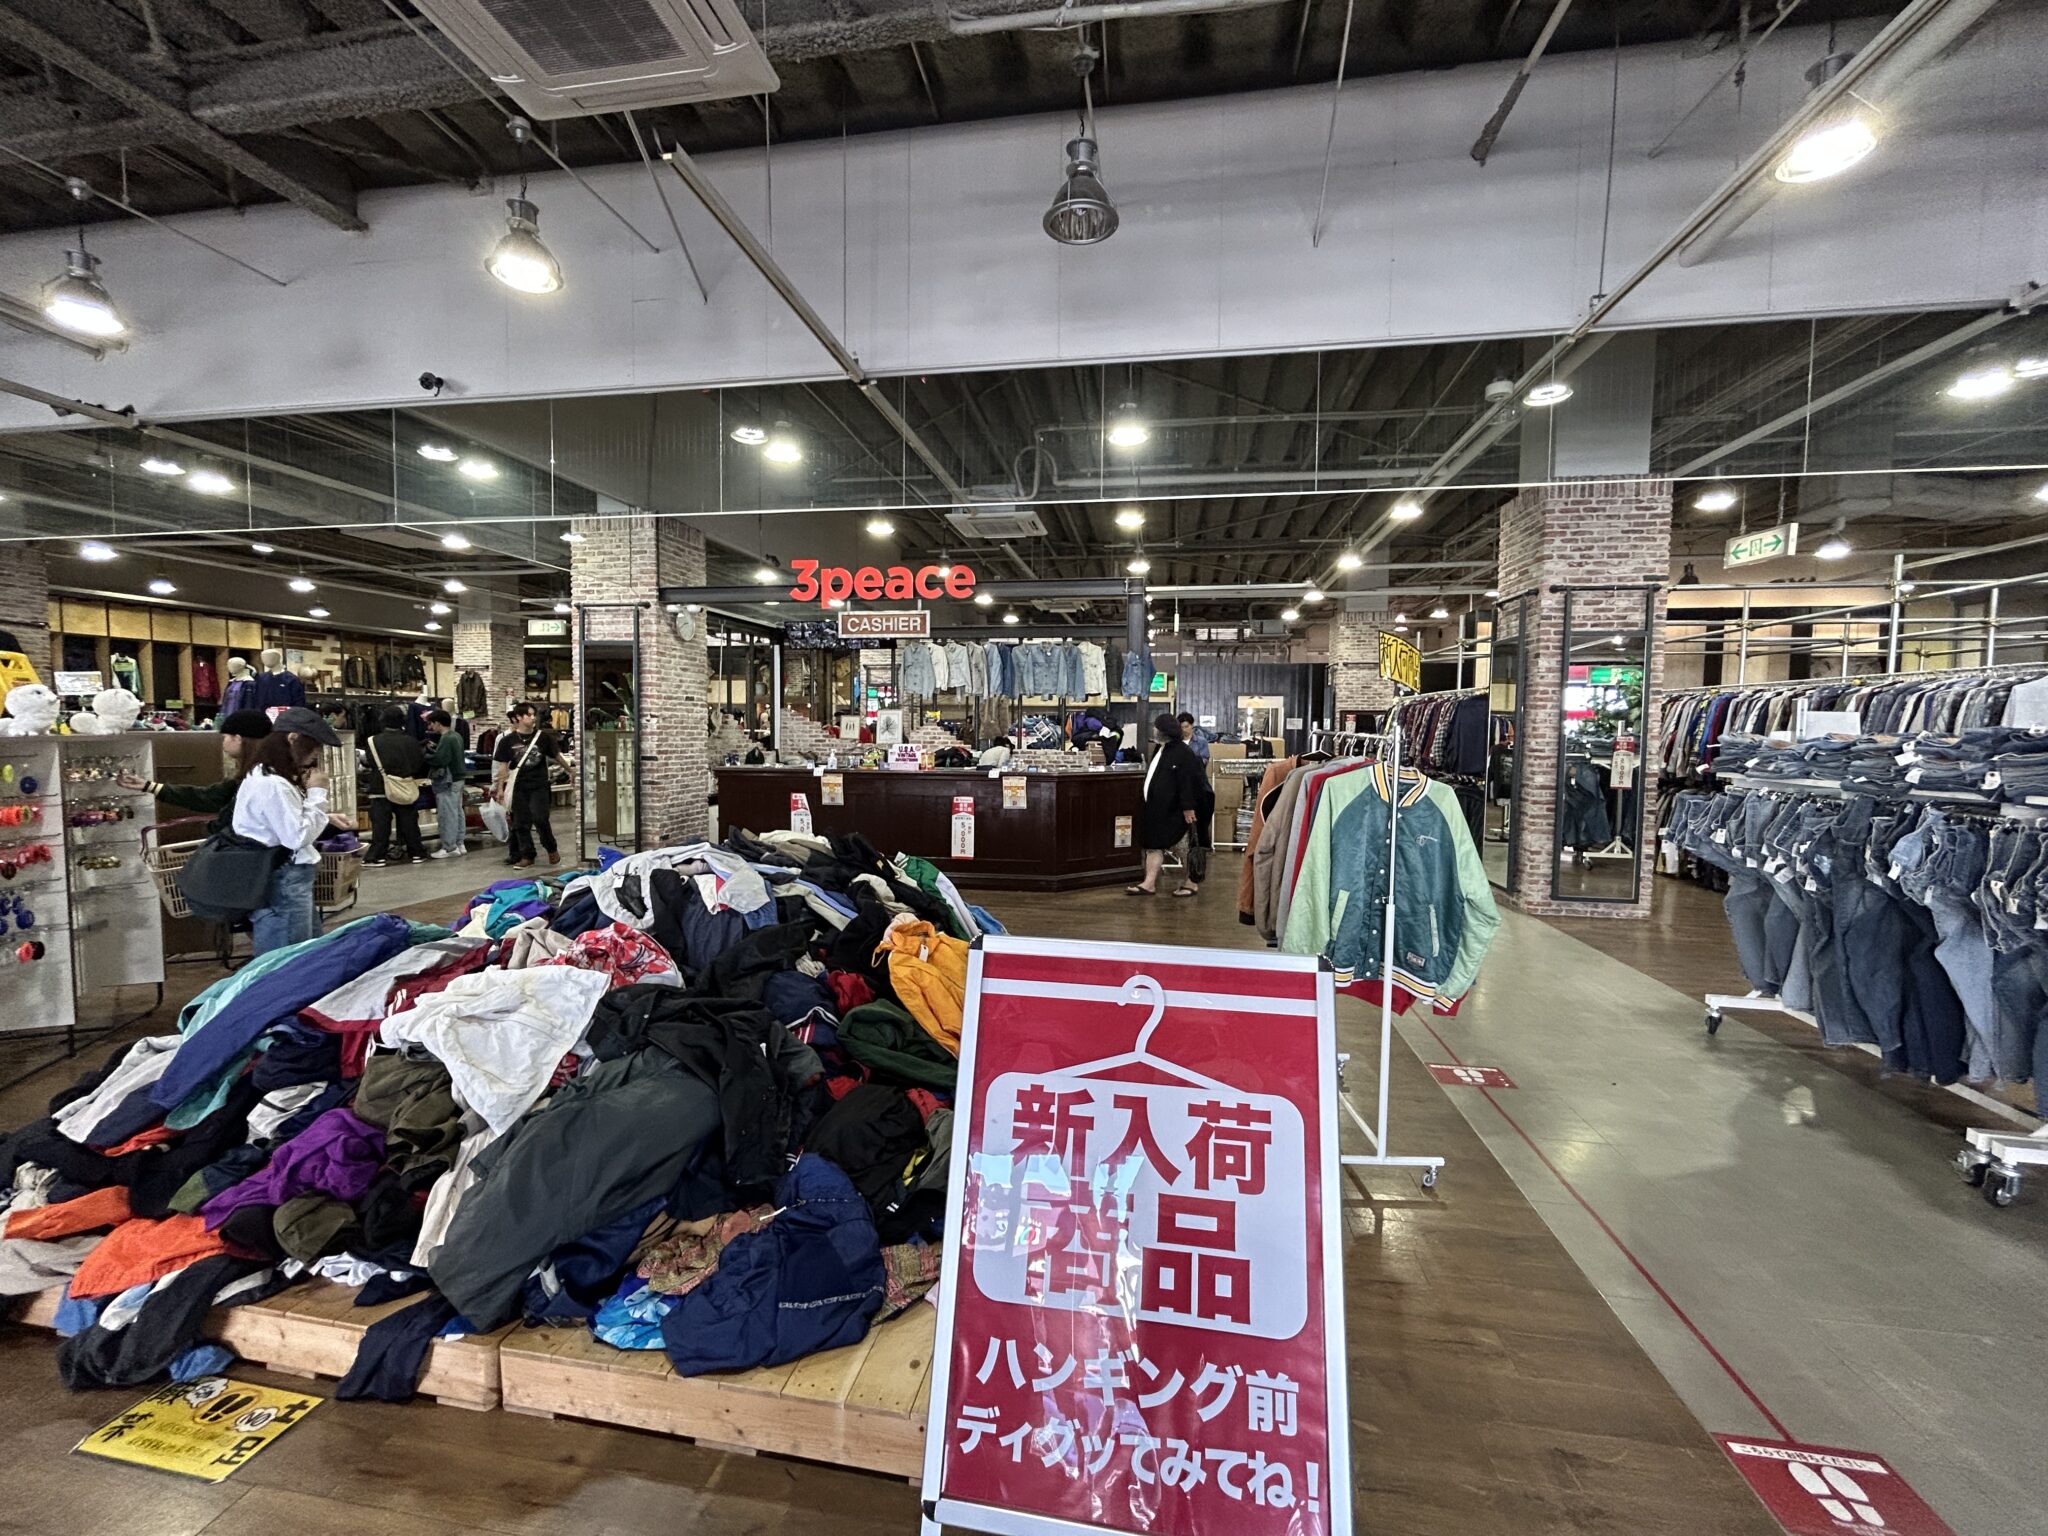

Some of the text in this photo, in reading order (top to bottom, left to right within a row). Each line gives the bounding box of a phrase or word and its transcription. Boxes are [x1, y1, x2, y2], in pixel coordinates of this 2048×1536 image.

[789, 559, 976, 609] 3peace
[847, 617, 921, 632] CASHIER
[1010, 1084, 1272, 1195] 新入荷
[1025, 1179, 1251, 1325] 商品
[239, 1410, 273, 1428] NO
[976, 1337, 1300, 1437] ハンギング前
